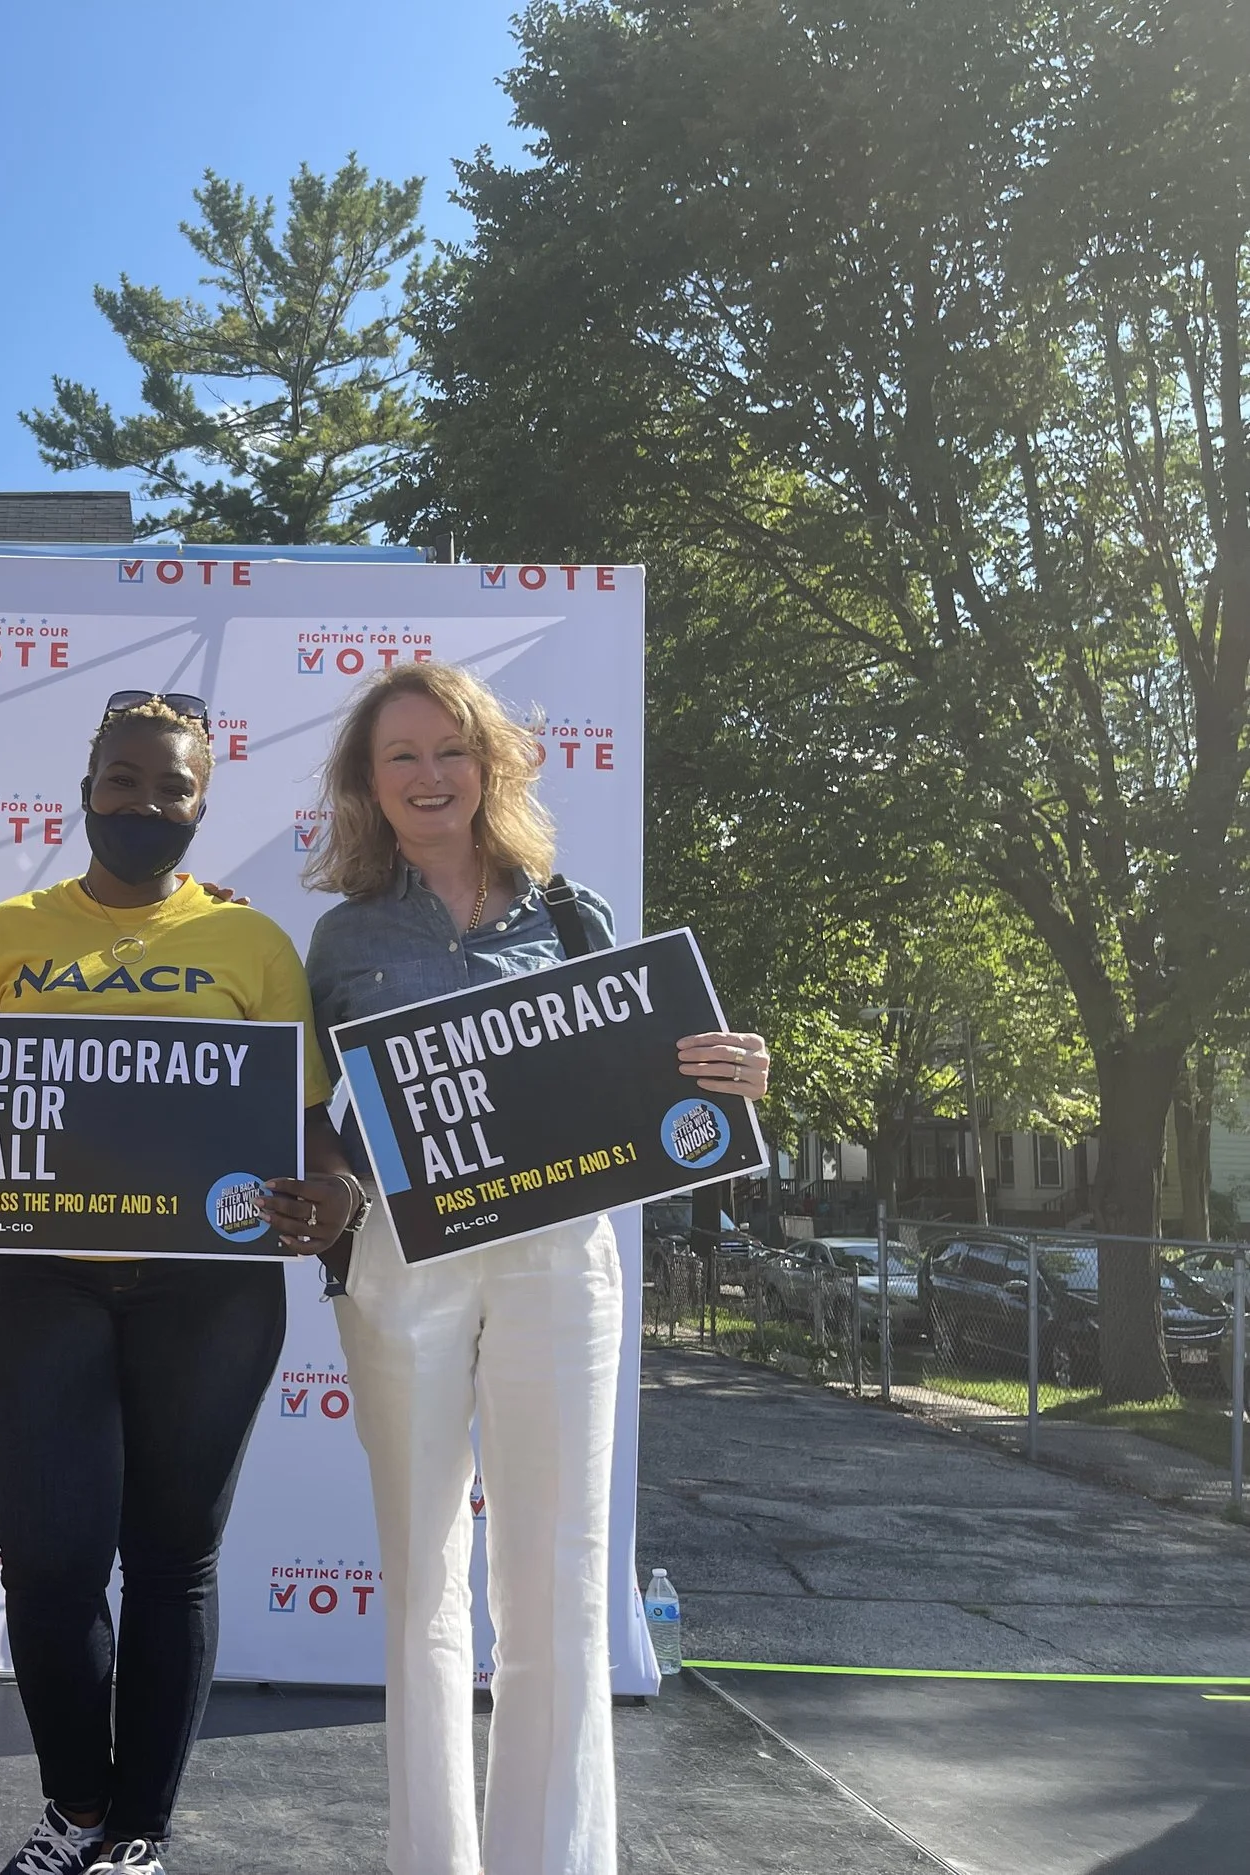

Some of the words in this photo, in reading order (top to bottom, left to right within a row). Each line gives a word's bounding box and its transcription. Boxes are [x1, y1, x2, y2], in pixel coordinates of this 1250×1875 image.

[119, 560, 250, 585] VOTE
[481, 565, 615, 590] VOTE
[8, 627, 34, 636] FOR
[39, 627, 68, 637] OUR
[298, 634, 364, 643] FIGHTING
[370, 635, 396, 643] FOR
[402, 635, 431, 644] OUR
[218, 720, 247, 729] OUR
[552, 727, 578, 736] FOR
[584, 728, 613, 738] OUR
[1, 802, 27, 812] FOR
[33, 803, 62, 813] OUR
[295, 811, 334, 820] FIGHT
[14, 959, 215, 998] NAACP
[385, 966, 654, 1083] DEMOCRACY
[402, 1068, 496, 1133] FOR
[671, 1121, 695, 1142] BETTER
[693, 1111, 710, 1128] WITH
[674, 1121, 716, 1158] UNIONS
[421, 1121, 505, 1185] ALL
[240, 1181, 255, 1192] BACK
[434, 1187, 476, 1215] PASS
[476, 1178, 510, 1203] THE
[510, 1168, 543, 1194] PRO
[545, 1159, 575, 1184] ACT
[578, 1149, 611, 1176] AND
[611, 1142, 638, 1166] S.1
[23, 1193, 50, 1212] THE
[55, 1193, 84, 1213] PRO
[88, 1194, 117, 1214] ACT
[121, 1195, 151, 1214] AND
[156, 1195, 178, 1215] S.1
[216, 1193, 241, 1208] BETTER
[216, 1202, 260, 1226] UNIONS
[444, 1213, 499, 1235] AFL-CIO
[281, 1388, 349, 1419] VO
[272, 1567, 339, 1580] FIGHTING
[345, 1570, 372, 1580] FOR
[269, 1584, 374, 1615] VOT
